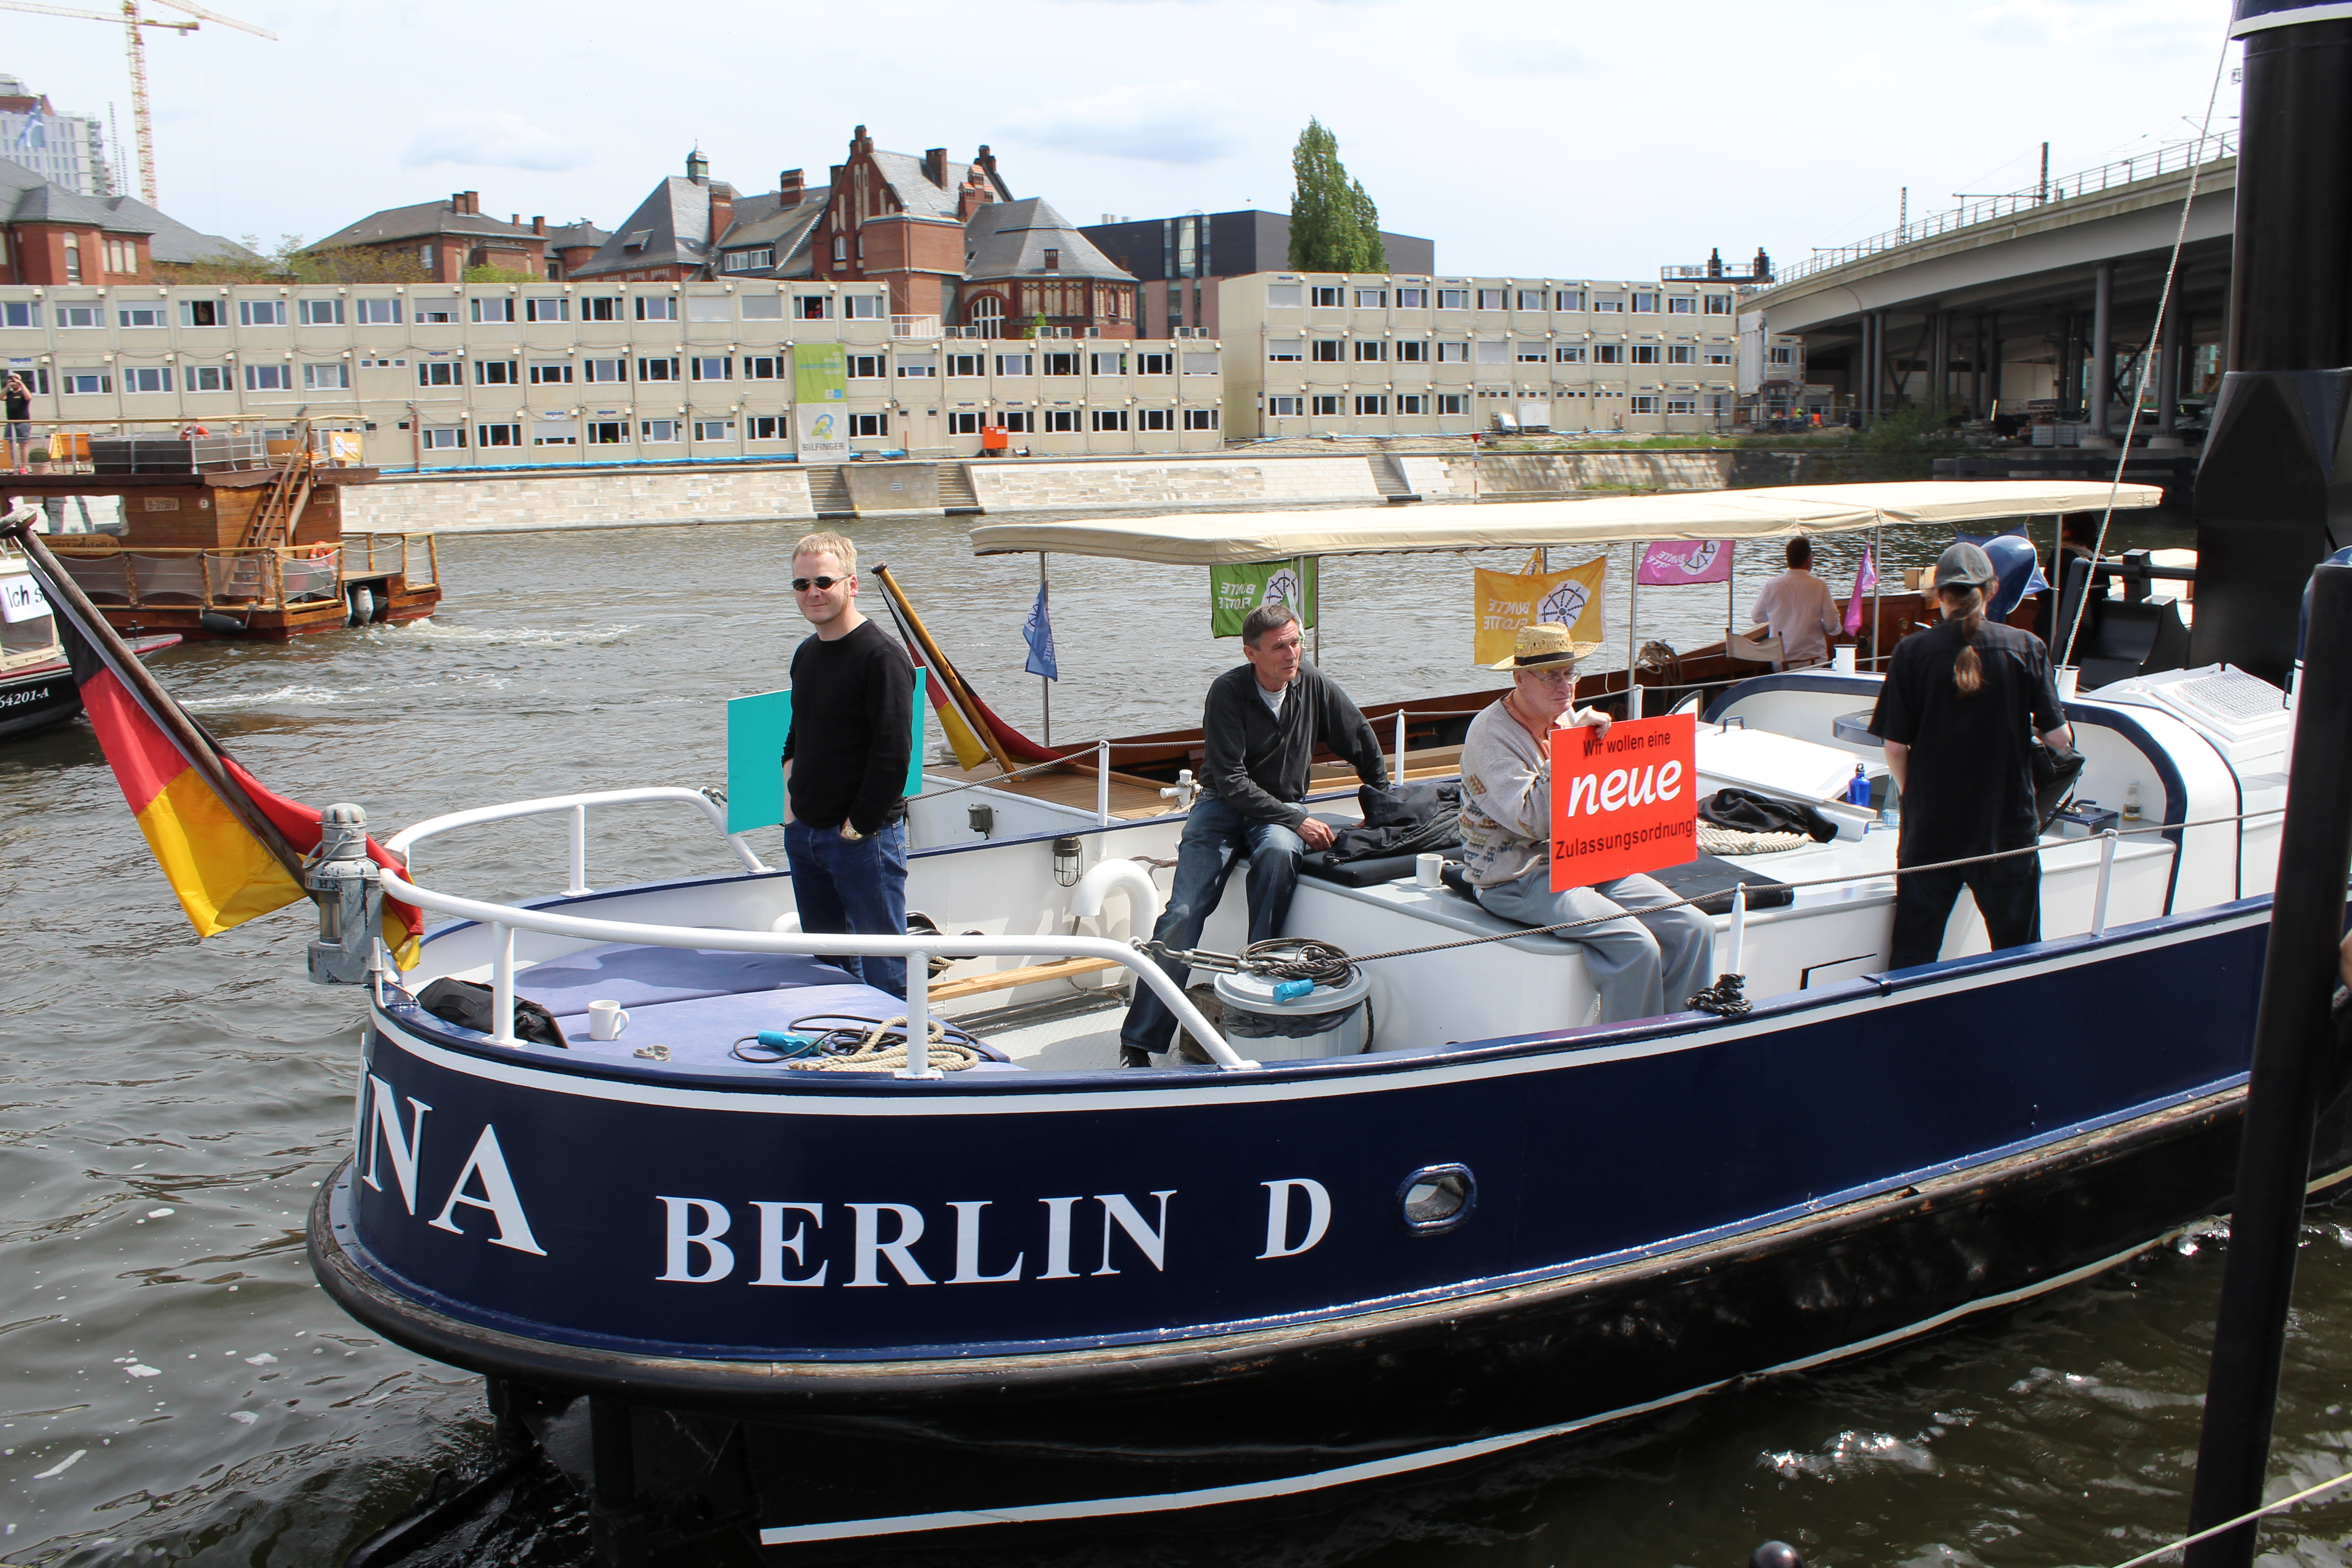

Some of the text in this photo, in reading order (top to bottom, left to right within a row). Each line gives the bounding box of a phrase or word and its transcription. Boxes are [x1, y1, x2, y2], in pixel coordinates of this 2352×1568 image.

[5, 584, 30, 608] Ich
[1583, 731, 1671, 757] Wir wollen eine
[1567, 760, 1682, 817] neue
[353, 1032, 548, 1256] NA
[655, 1178, 1332, 1288] BERLIN D
